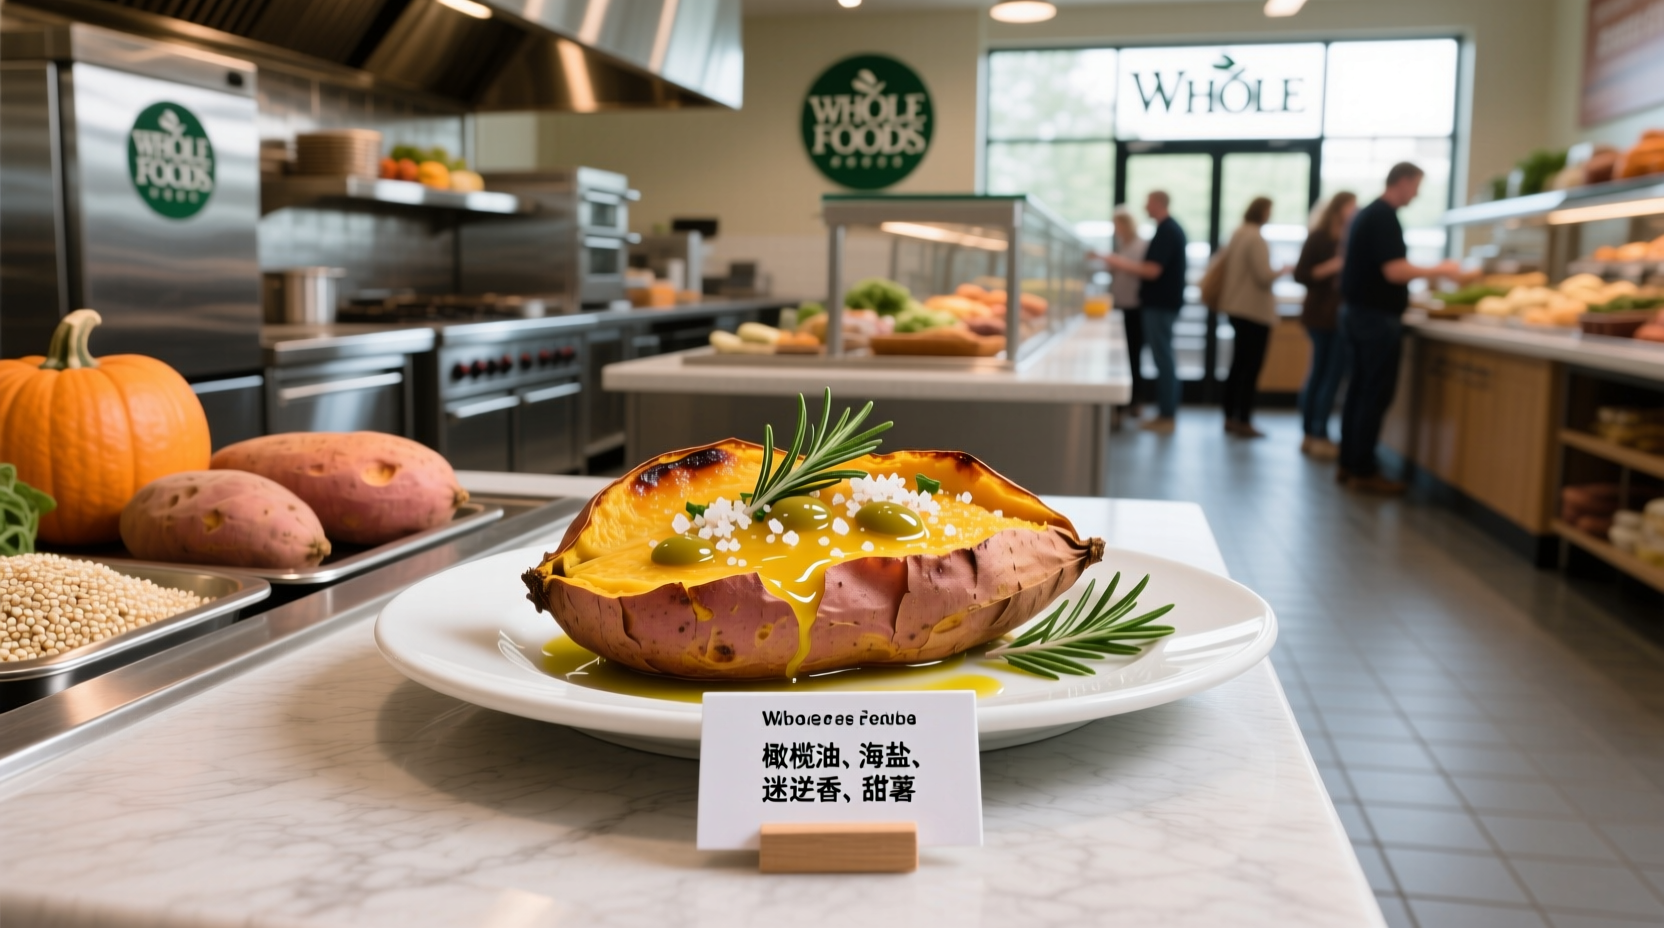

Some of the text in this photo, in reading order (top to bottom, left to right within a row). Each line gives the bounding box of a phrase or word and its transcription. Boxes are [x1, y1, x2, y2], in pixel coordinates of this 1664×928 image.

[1131, 71, 1305, 113] WHOLE
[809, 93, 927, 126] WHOLE
[132, 128, 211, 162] WHOLE
[812, 123, 926, 155] FOODS
[136, 155, 213, 193] FOODS
